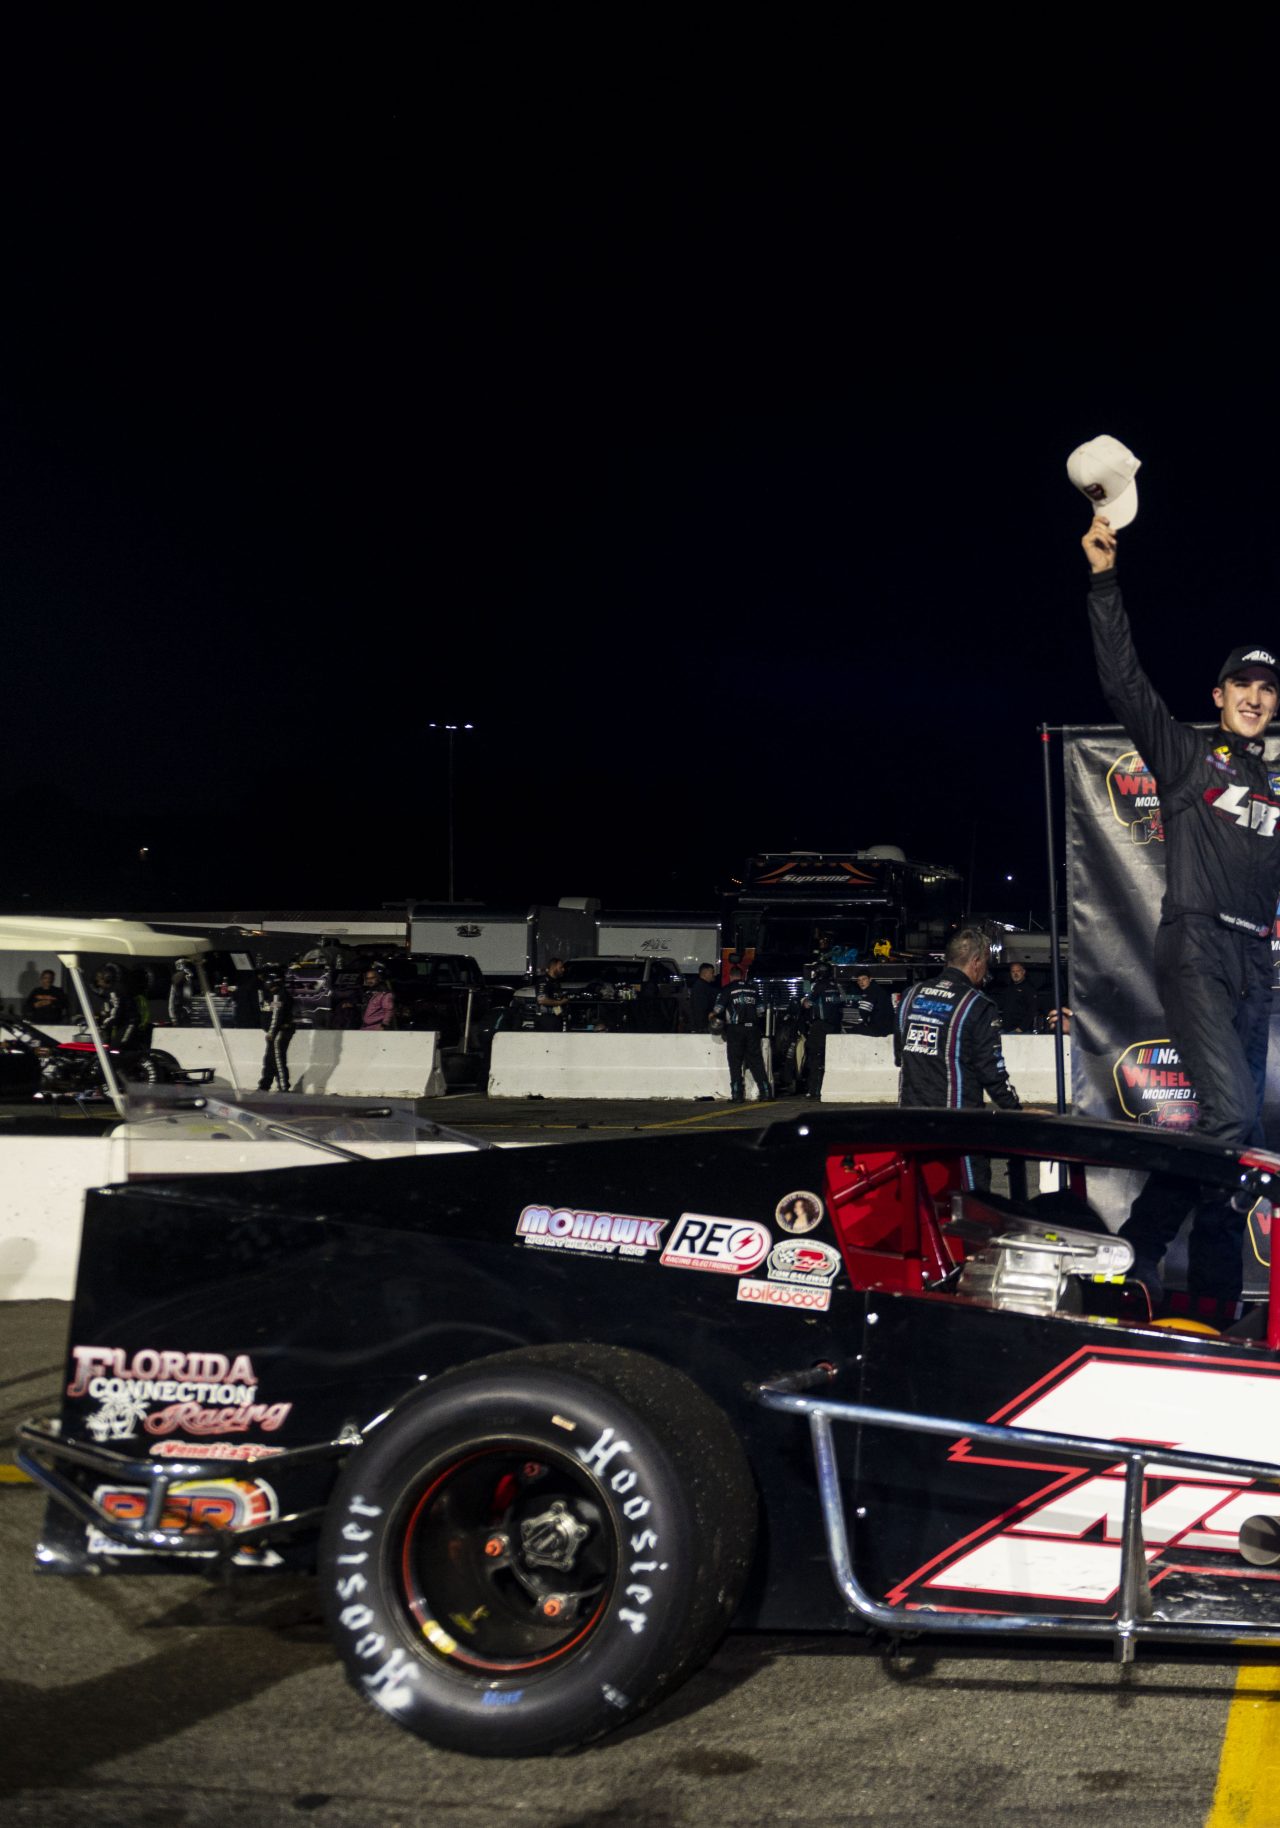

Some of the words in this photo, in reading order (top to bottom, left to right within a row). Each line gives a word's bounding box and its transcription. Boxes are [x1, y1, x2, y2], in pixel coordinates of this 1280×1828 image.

[908, 1029, 936, 1043] EPIC
[1121, 1064, 1193, 1089] WHEL
[1142, 1088, 1190, 1099] MODIFIED
[519, 1207, 663, 1247] MOHAWK
[665, 1257, 692, 1267] RACING
[67, 1346, 258, 1396] FLORIDA
[89, 1378, 257, 1404] CONNECTION
[144, 1402, 292, 1435] Racing
[576, 1428, 669, 1635] Hoosier
[336, 1495, 424, 1712] Hoosier
